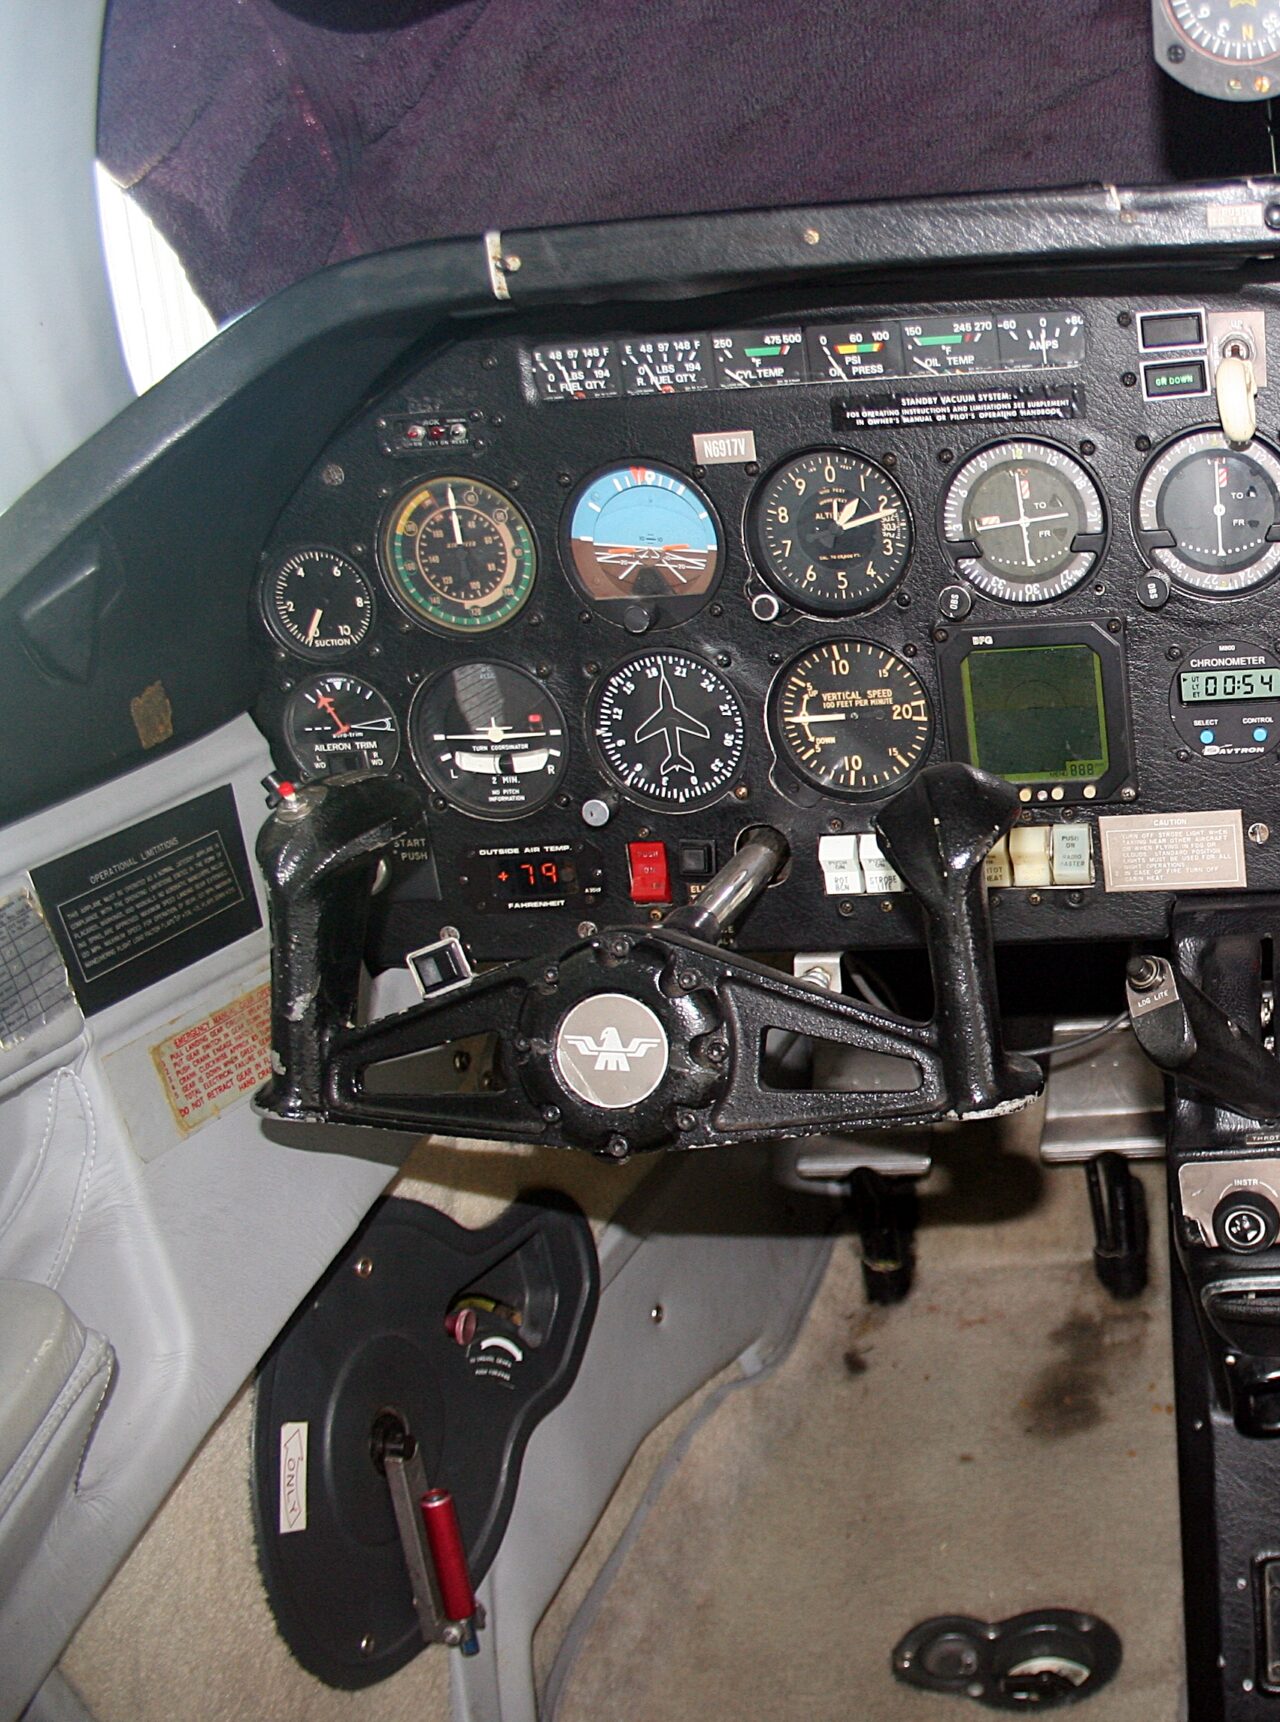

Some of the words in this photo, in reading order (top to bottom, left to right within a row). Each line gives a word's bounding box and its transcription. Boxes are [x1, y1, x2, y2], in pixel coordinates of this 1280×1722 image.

[905, 326, 921, 336] 150
[974, 321, 992, 331] 270
[714, 339, 732, 348] 250
[764, 335, 782, 344] 475
[782, 334, 802, 343] 500
[850, 332, 862, 342] 60
[872, 332, 889, 341] 100
[640, 344, 653, 353] 48
[658, 343, 669, 352] 97
[674, 341, 690, 350] 148
[567, 350, 578, 359] 97
[583, 348, 599, 358] 148
[845, 356, 861, 364] PSI
[925, 358, 940, 367] OIL
[594, 370, 610, 378] 194
[656, 364, 674, 374] LBS
[685, 362, 701, 372] 194
[852, 365, 883, 375] PRESS
[1169, 375, 1193, 385] DOWN
[902, 398, 937, 406] STANDBY
[941, 395, 975, 404] VACUUM
[978, 393, 1012, 402] SYSTEM:
[902, 407, 950, 416] INSTRUCTIONS
[970, 403, 1011, 412] LIMITATIONS
[902, 415, 932, 424] MANUAL
[979, 410, 1017, 419] OPERATING
[704, 438, 745, 458] N6917V
[315, 638, 350, 647] SUCTION
[972, 636, 993, 646] BFG
[832, 660, 849, 675] 10
[1191, 656, 1265, 668] CHRONOMETER
[879, 669, 888, 677] 15
[1204, 674, 1274, 697] 00:54
[822, 691, 861, 701] VERTICAL
[867, 689, 892, 698] SPEED
[893, 706, 912, 720] 20
[1242, 716, 1274, 724] CONTROL
[314, 743, 351, 752] AILERON
[355, 742, 377, 750] TRIM
[844, 755, 862, 770] 10
[502, 776, 520, 784] MIN.
[89, 857, 138, 885] OPERATIONAL
[140, 837, 179, 861] LIMITATIONS
[401, 852, 428, 860] PUSH
[508, 900, 565, 909] FAHRENHEIT
[174, 1023, 210, 1048] EMERGENCY
[207, 1079, 233, 1098] RETRACT
[285, 1457, 298, 1512] ONLY
